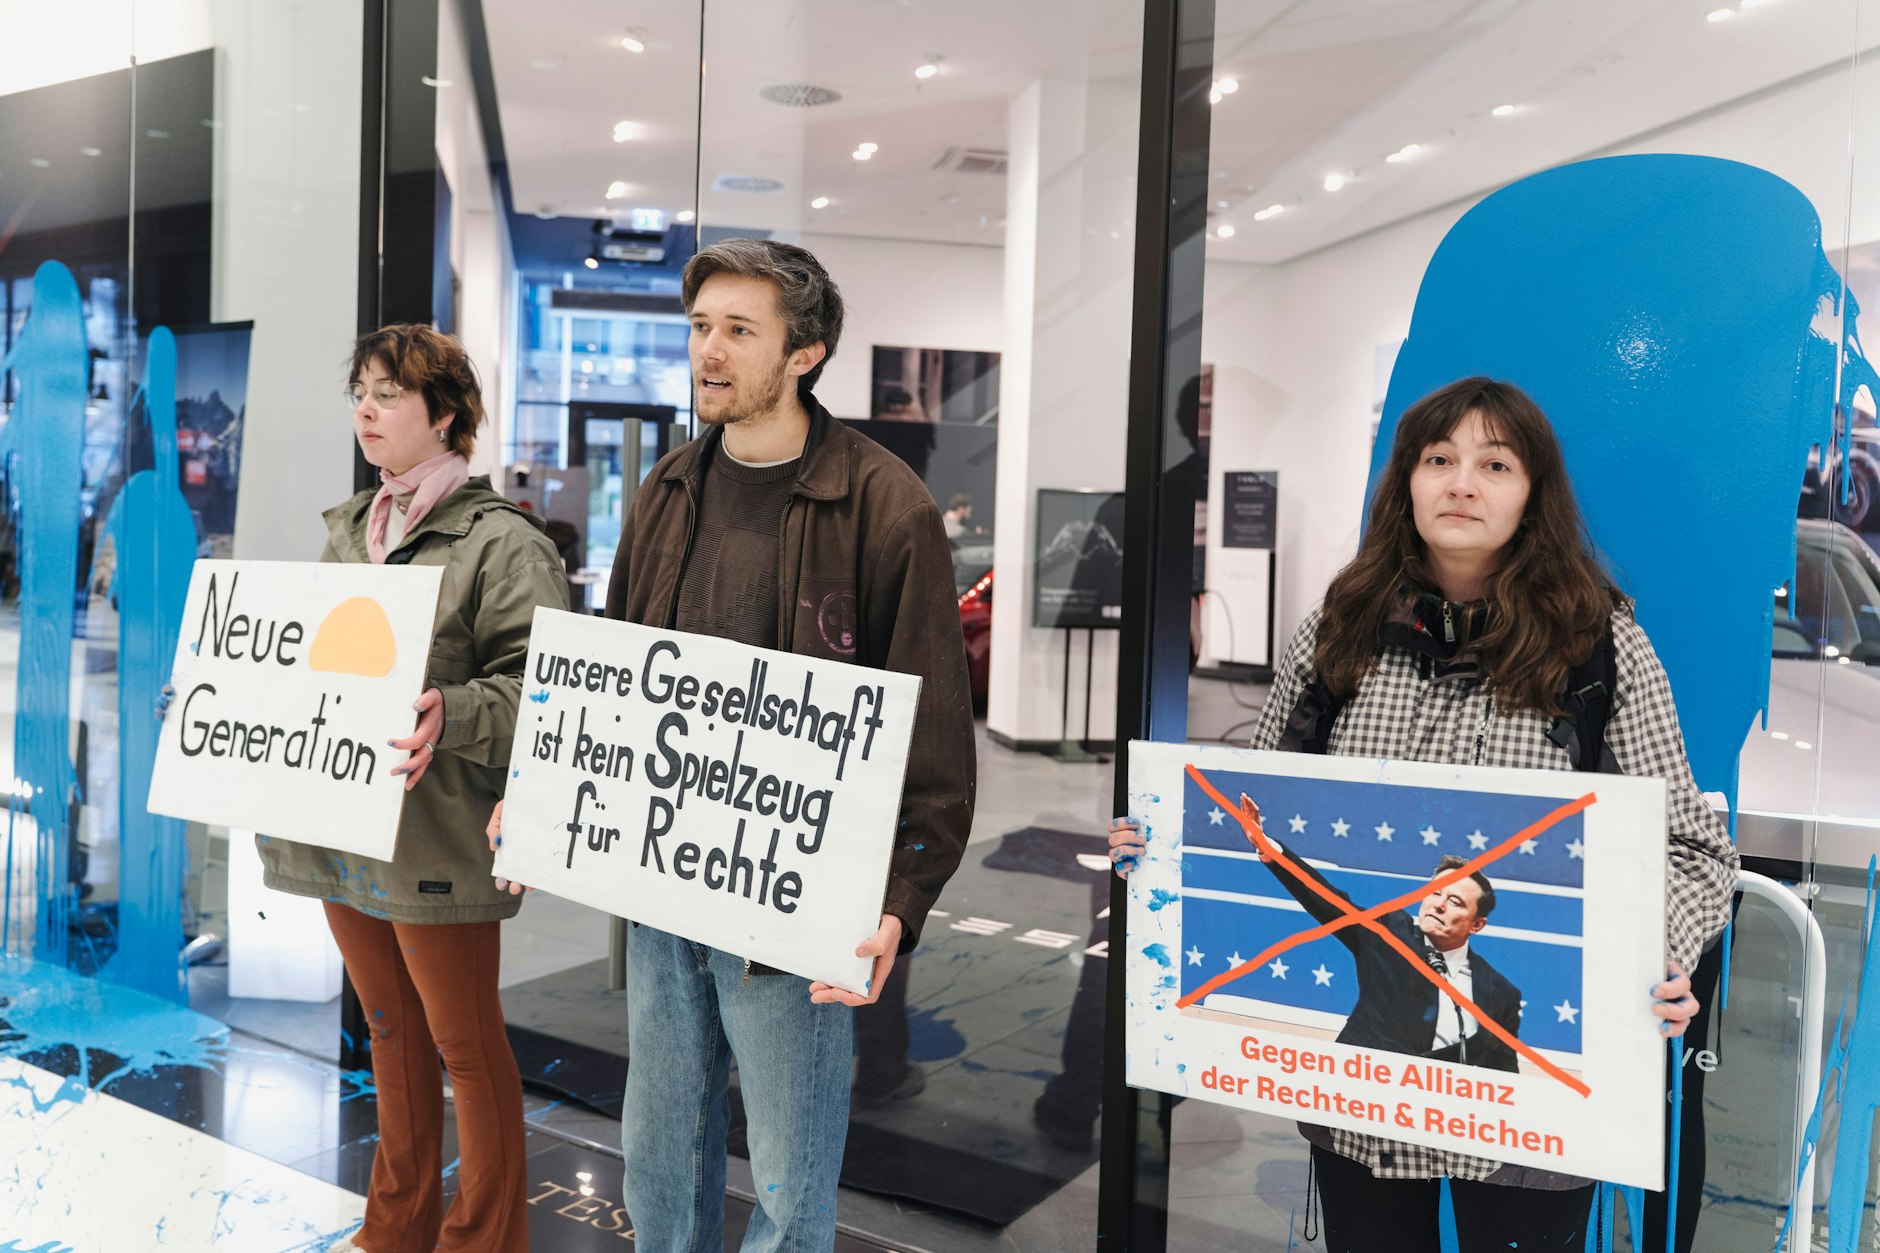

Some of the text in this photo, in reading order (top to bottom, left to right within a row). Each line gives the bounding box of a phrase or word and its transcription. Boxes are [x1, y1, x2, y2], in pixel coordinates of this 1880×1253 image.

[196, 571, 304, 666] Neue
[180, 683, 376, 785] Generation
[535, 640, 884, 781] unsere Gesellschaft
[532, 706, 834, 855] ist kein Spielzeug
[566, 780, 803, 914] für Rechte
[1201, 1065, 1564, 1156] der Rechten & Reichen
[1240, 1036, 1515, 1105] Gegen die Allianz
